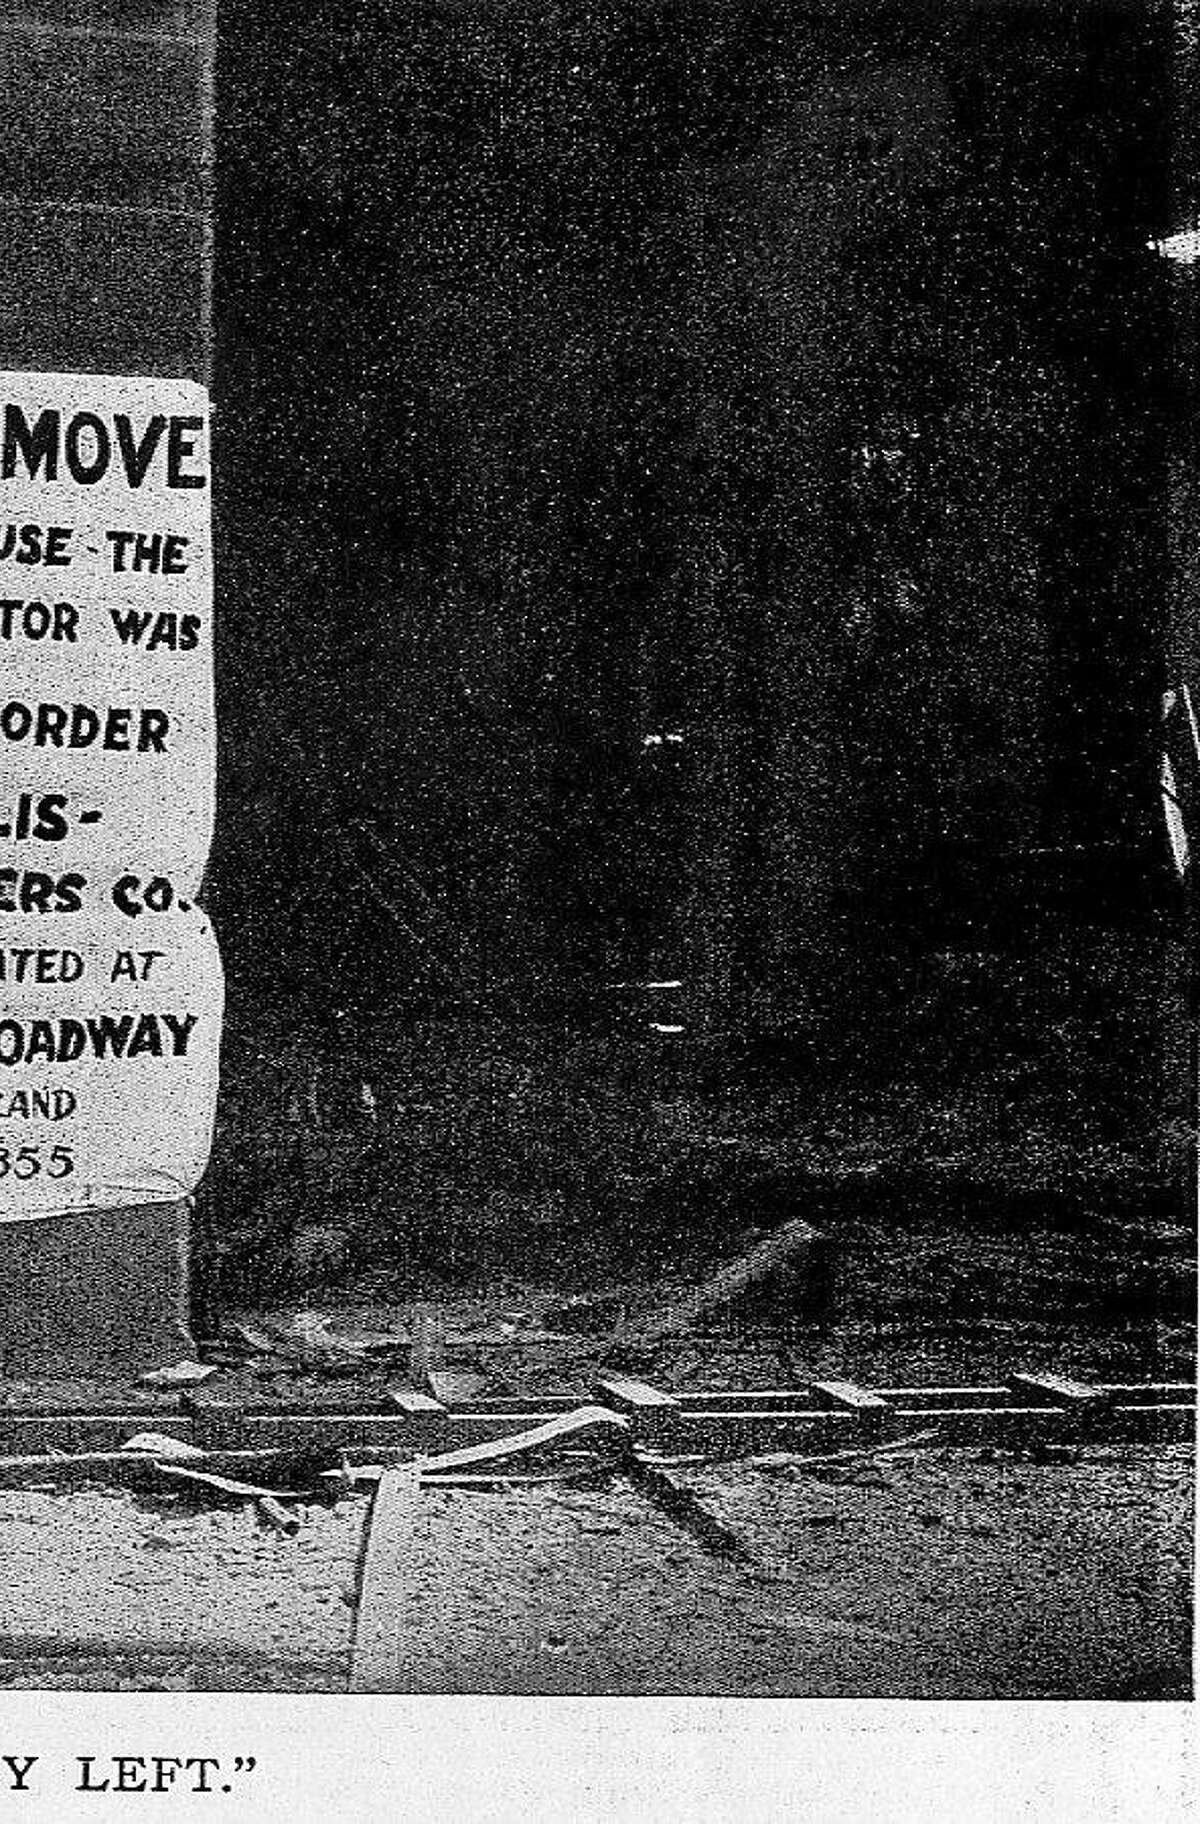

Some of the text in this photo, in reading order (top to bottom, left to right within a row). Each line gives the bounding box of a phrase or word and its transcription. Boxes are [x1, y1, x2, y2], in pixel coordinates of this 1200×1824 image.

[2, 403, 206, 489] MOVE
[105, 530, 189, 575] THE
[110, 608, 202, 652] WAS
[0, 701, 170, 753] ORDER
[111, 873, 193, 918] CO.
[111, 950, 167, 984] AT
